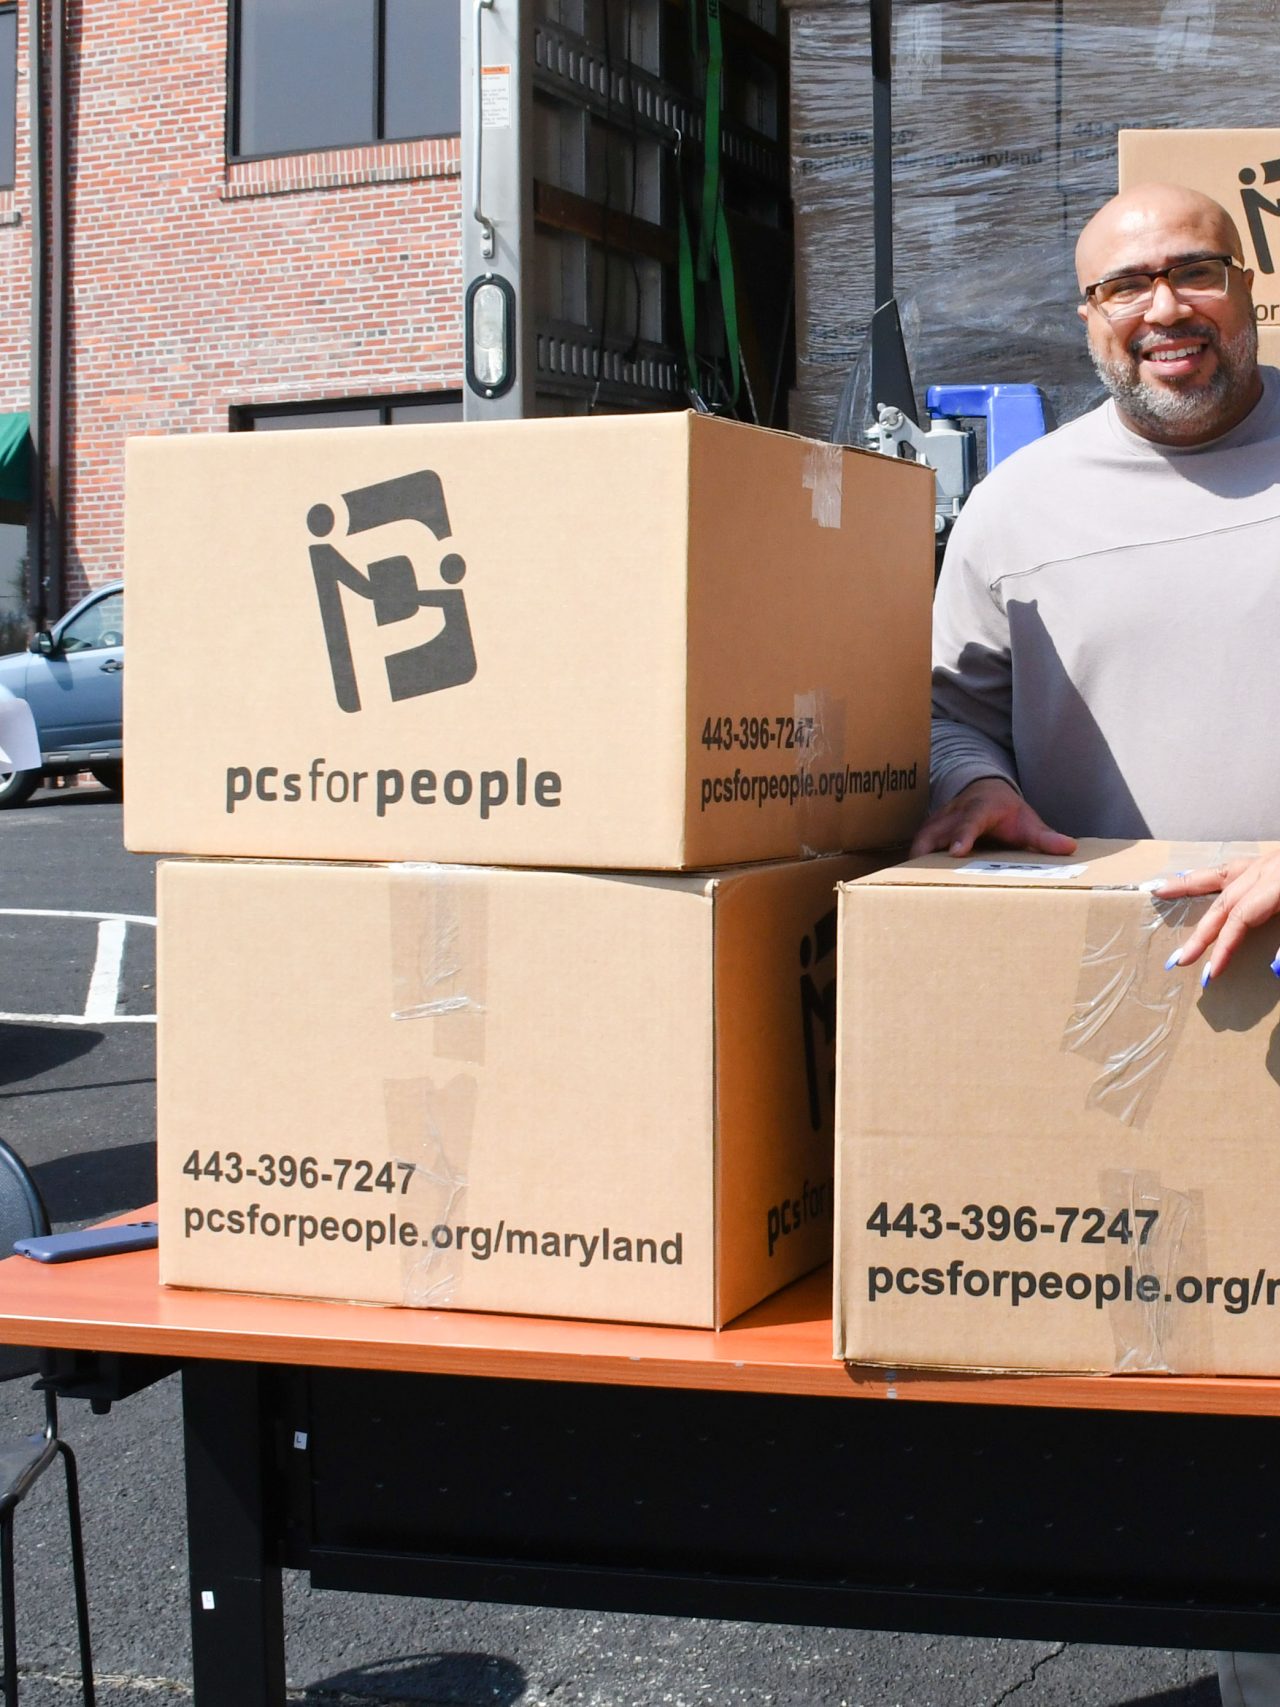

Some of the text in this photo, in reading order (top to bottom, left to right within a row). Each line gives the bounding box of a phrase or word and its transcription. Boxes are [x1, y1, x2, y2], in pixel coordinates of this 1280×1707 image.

[702, 717, 814, 751] 443-396-7247
[226, 756, 563, 820] pcsforpeople
[701, 762, 917, 813] pcsforpeople.org/maryland
[182, 1149, 417, 1195] 443-396-7247
[183, 1203, 684, 1269] pcsforpeople.org/maryland
[768, 1180, 826, 1257] pcsfor
[866, 1202, 1159, 1244] 443-396-7247
